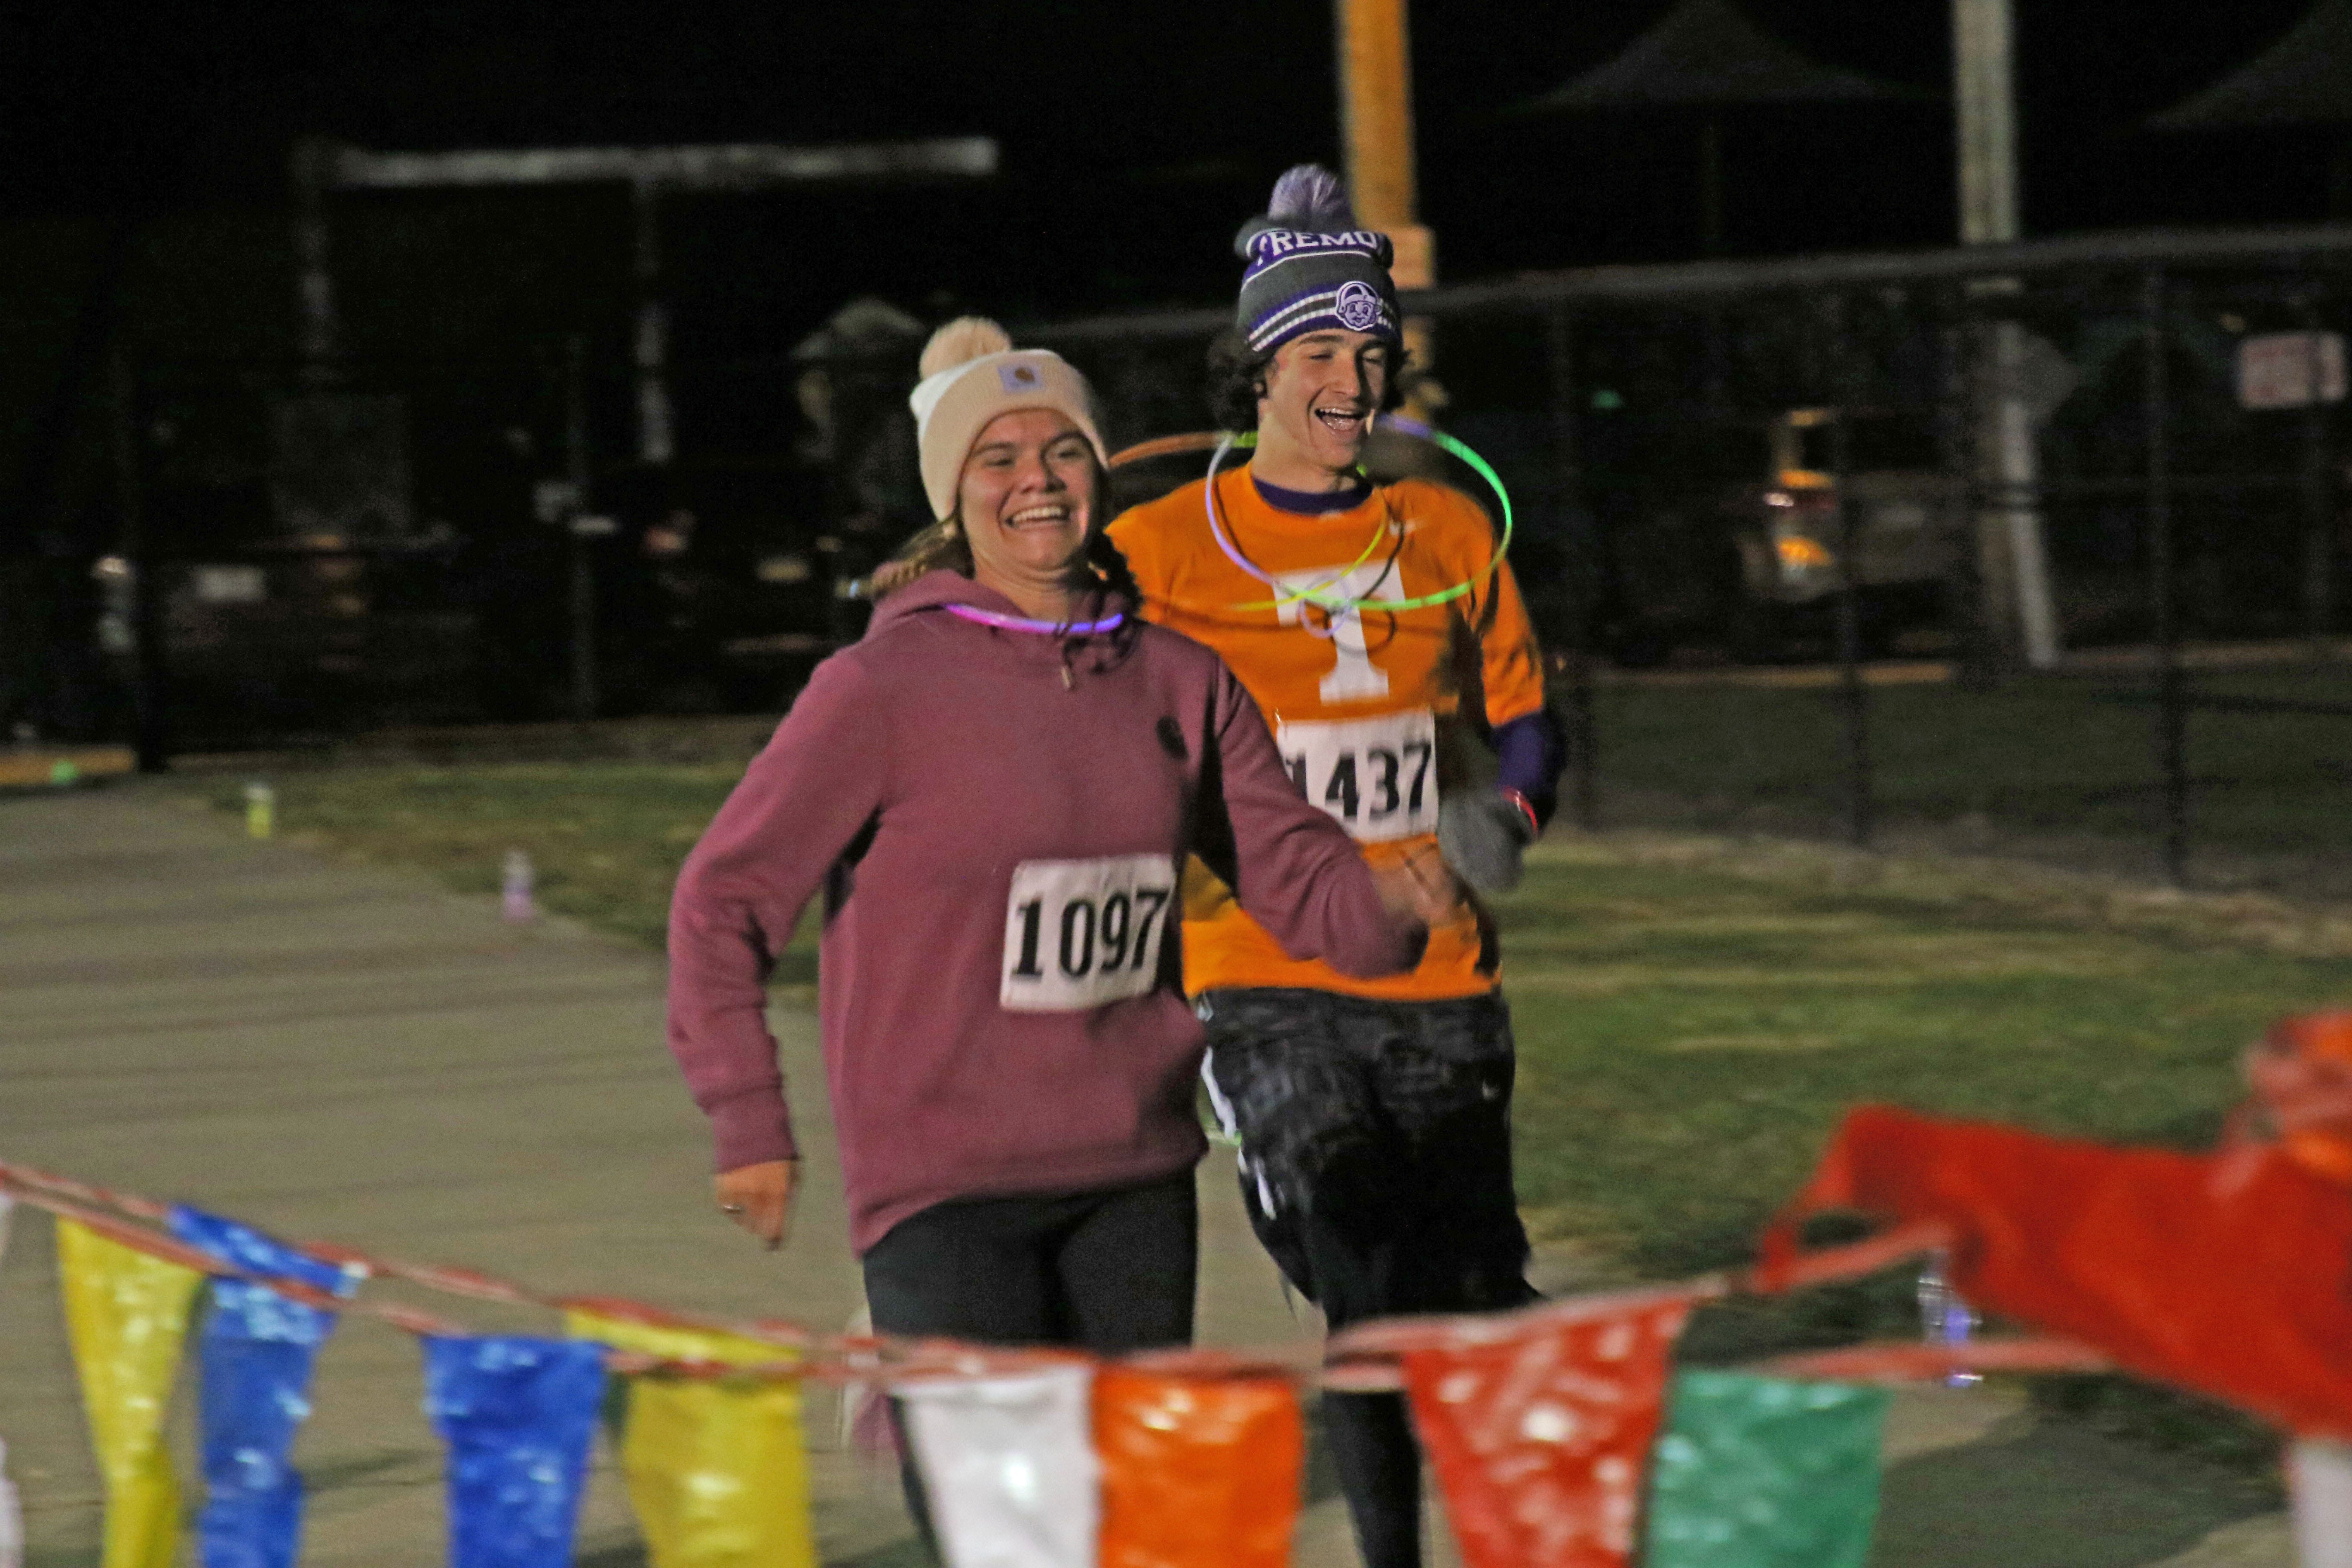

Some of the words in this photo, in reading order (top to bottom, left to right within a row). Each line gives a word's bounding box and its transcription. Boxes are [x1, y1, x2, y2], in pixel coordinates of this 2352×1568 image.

[1272, 560, 1405, 704] T
[1286, 739, 1431, 818] 1437
[1011, 887, 1169, 982] 1097
